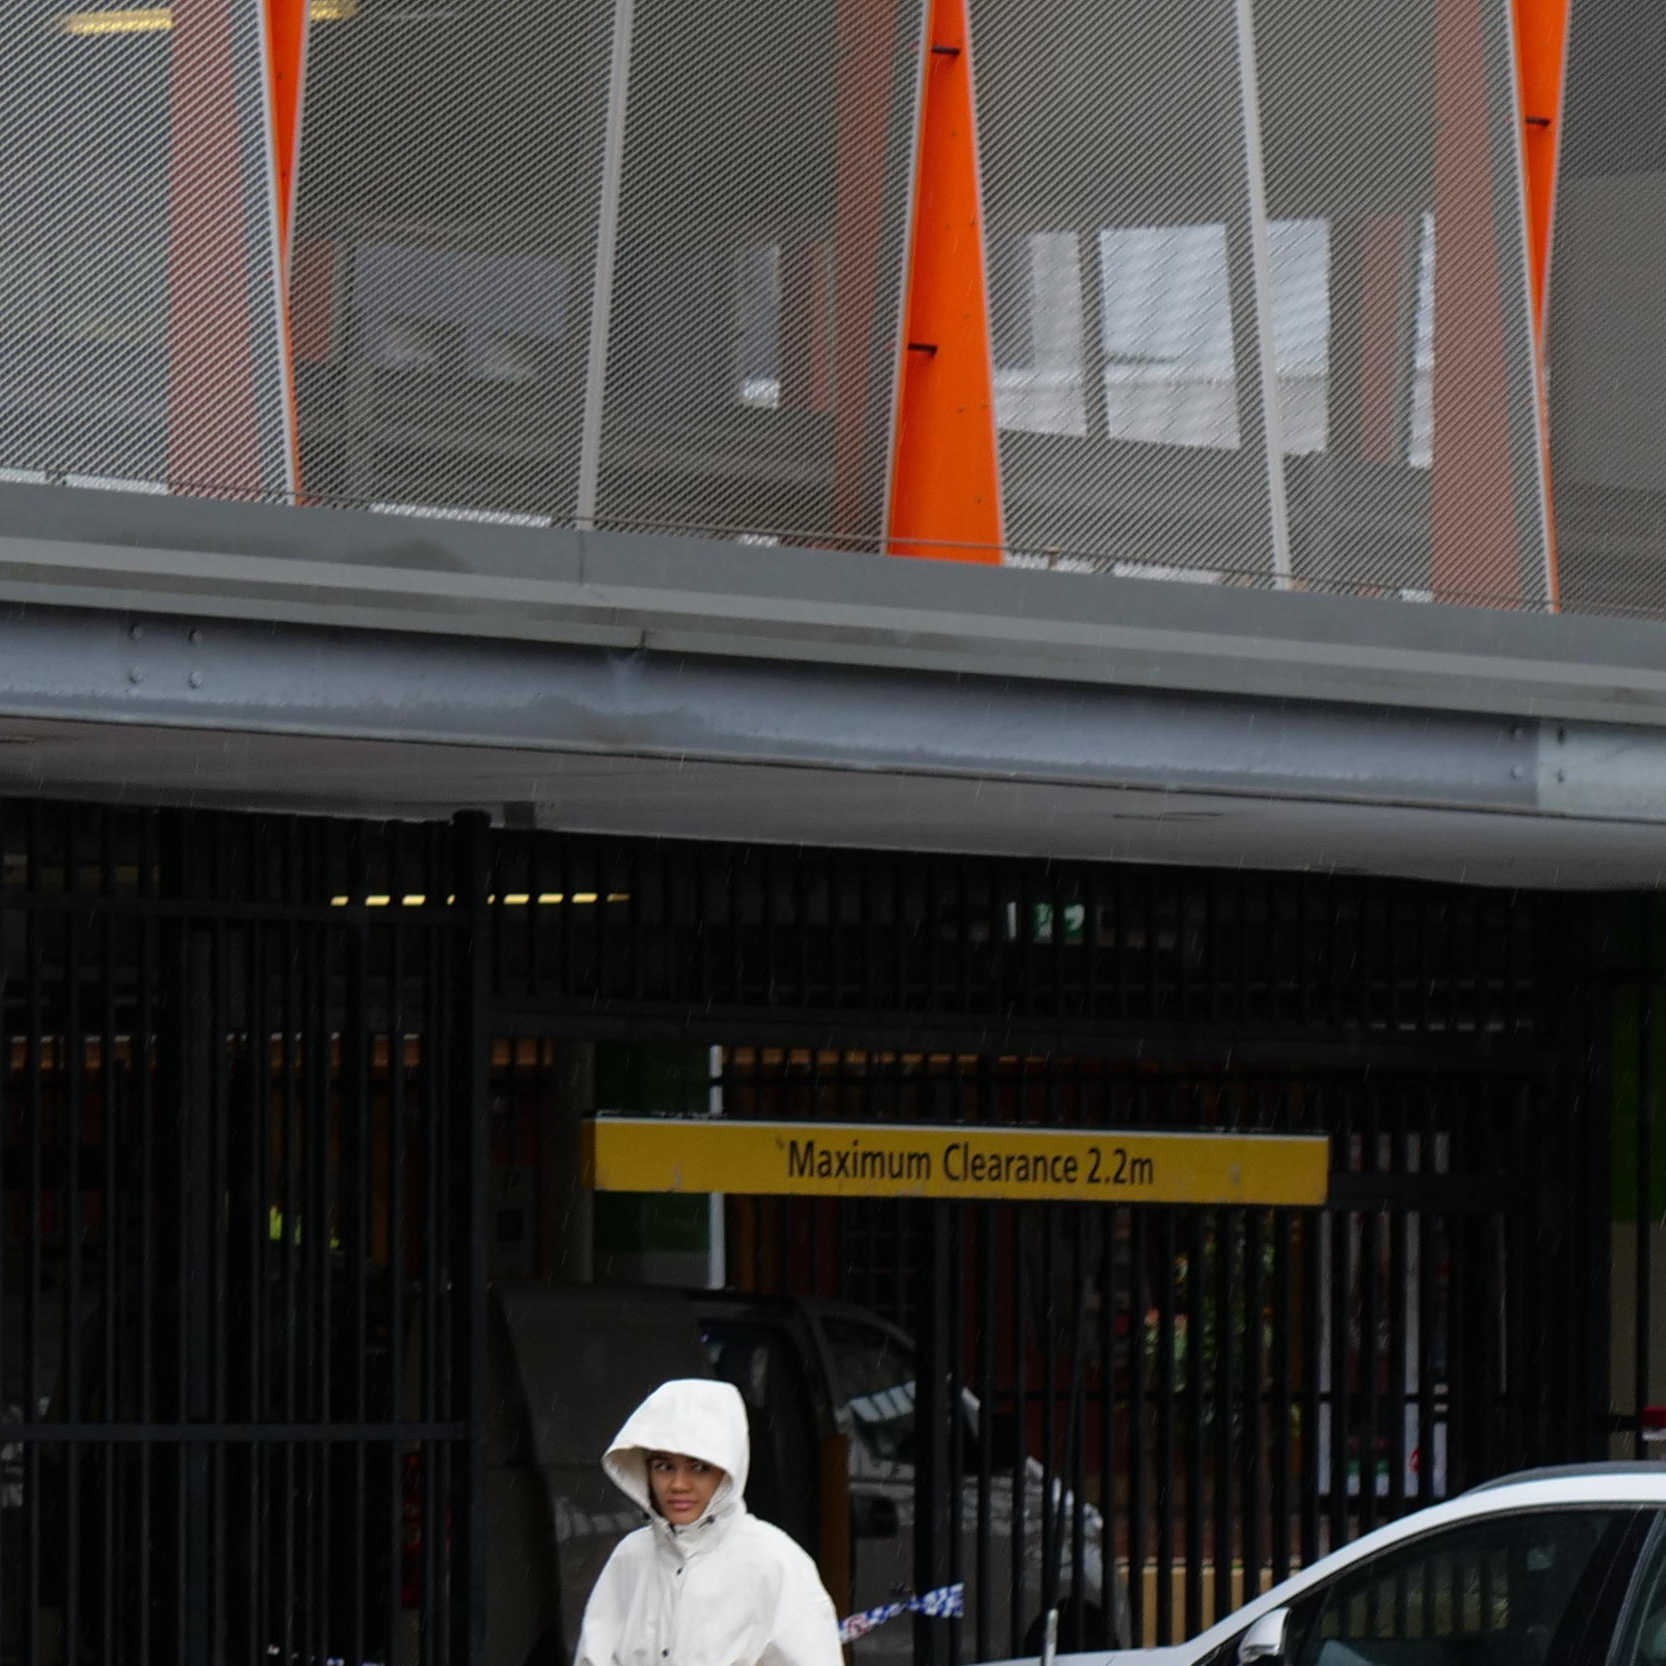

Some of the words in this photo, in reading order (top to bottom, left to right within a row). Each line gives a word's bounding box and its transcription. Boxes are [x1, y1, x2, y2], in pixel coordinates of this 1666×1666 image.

[787, 1139, 931, 1180] Maximum
[943, 1143, 1079, 1184] Clearance
[1086, 1148, 1155, 1186] 2.2m
